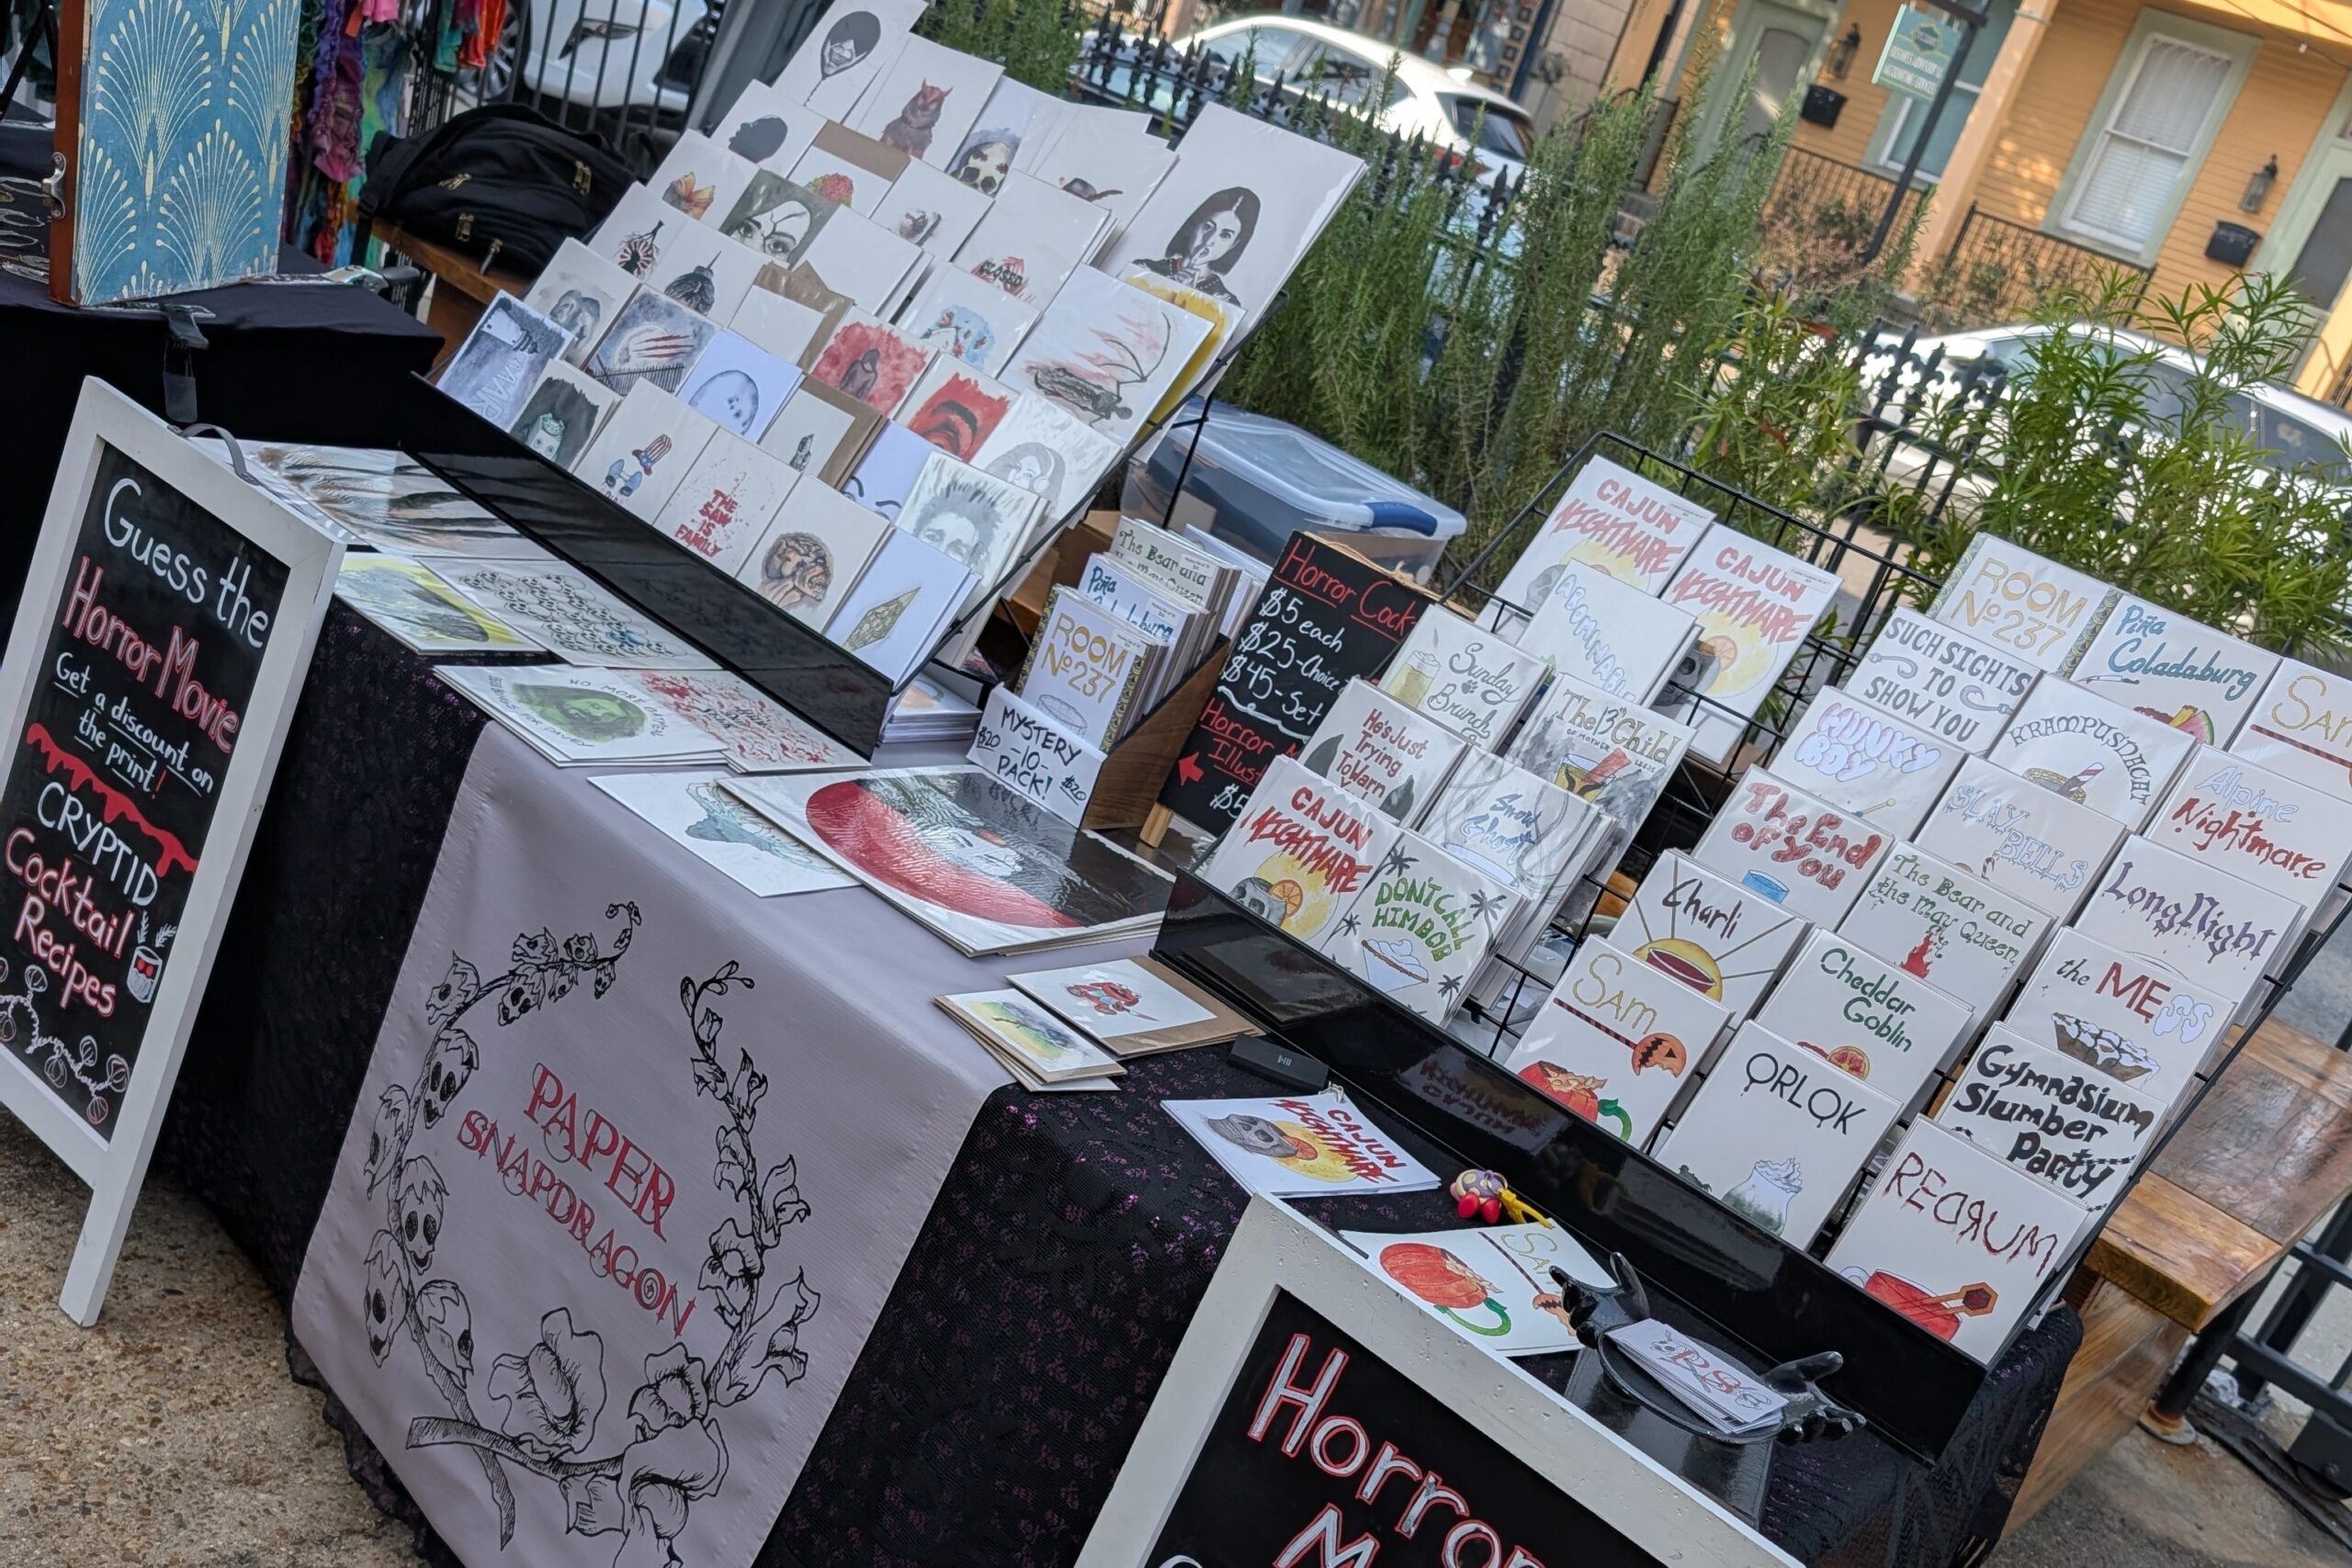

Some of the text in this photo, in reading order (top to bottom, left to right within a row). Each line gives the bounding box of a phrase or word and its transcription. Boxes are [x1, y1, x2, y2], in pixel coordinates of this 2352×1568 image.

[698, 502, 732, 528] SAW
[699, 521, 716, 537] IS
[713, 489, 738, 513] THE
[1596, 479, 1681, 536] CAJUN
[104, 478, 269, 649] Guess the
[674, 524, 724, 558] FAMILY
[1119, 530, 1143, 555] The
[1146, 545, 1179, 571] Bear
[1549, 498, 1686, 577] NIGHTMARE
[1281, 538, 1417, 637] Horror Cock
[1668, 568, 1814, 646] NIGHTMARE
[1714, 547, 1808, 604] CAJUN
[1972, 558, 2088, 628] ROOM
[1052, 613, 1128, 678] ROOM
[1259, 587, 1346, 653] $5 each
[2115, 604, 2166, 637] Piña
[62, 555, 240, 753] Horror Movie
[1449, 642, 1521, 705] Sunday
[1884, 616, 2032, 696] SUCH SIGHTS
[1923, 666, 1955, 697] TO
[2108, 638, 2256, 702] Coladaburg
[55, 651, 215, 794] Get a discount on
[570, 678, 592, 687] NO
[600, 685, 646, 704] MORE
[1427, 682, 1498, 740] Brunch
[1863, 675, 1979, 742] SHOW YOU
[79, 708, 167, 799] the print!
[976, 726, 1001, 750] $20
[1001, 705, 1082, 766] MYSTERY
[1199, 697, 1275, 755] Horror
[1355, 729, 1403, 778] Trying
[1363, 708, 1430, 760] He's Just
[1556, 689, 1596, 730] The
[1611, 716, 1682, 766] Child
[1566, 728, 1578, 739] OF
[1578, 733, 1611, 750] MOTHER
[1794, 730, 1877, 782] BOY
[1816, 702, 1941, 773] HUNKY
[997, 755, 1054, 800] PACK!
[1061, 776, 1087, 803] $20
[1337, 750, 1352, 775] To
[1349, 760, 1386, 798] Warn
[2007, 715, 2153, 806] KRAMPUSNACHT
[1291, 786, 1374, 852] CAJUN
[1489, 794, 1542, 828] Snow
[1745, 783, 1882, 870] The End
[1942, 785, 2030, 836] SLAY
[2194, 765, 2300, 823] Alpine
[38, 783, 159, 906] CRYPTID
[1245, 806, 1373, 895] NIGHTMARE
[1460, 813, 1536, 866] Ghost
[1993, 829, 2088, 893] BELLS
[2172, 797, 2326, 879] Nightmare
[6, 828, 134, 958] Cocktail
[1375, 875, 1475, 950] DON'T CALL
[1662, 878, 1743, 942] Charli
[1870, 876, 2019, 963] the May Queen
[1894, 853, 2033, 939] The Bear and
[2102, 862, 2278, 964] Long Night
[14, 893, 117, 1017] Recipes
[1372, 907, 1453, 962] HIM BOB
[1820, 947, 1916, 1015] Cheddar
[2056, 958, 2214, 1043] the MESS
[1843, 997, 1913, 1053] Goblin
[1743, 1053, 1867, 1135] ORLOK
[1953, 1083, 2109, 1144] Slumber
[1977, 1044, 2154, 1142] Gymnasium
[524, 1063, 675, 1242] PAPER
[1268, 1099, 1399, 1183] NIGHTMARE
[1328, 1109, 1408, 1168] CAJUN
[2007, 1132, 2115, 1199] Party
[457, 1110, 696, 1338] SNAPDRAGON
[1883, 1152, 2058, 1280] REDRUM
